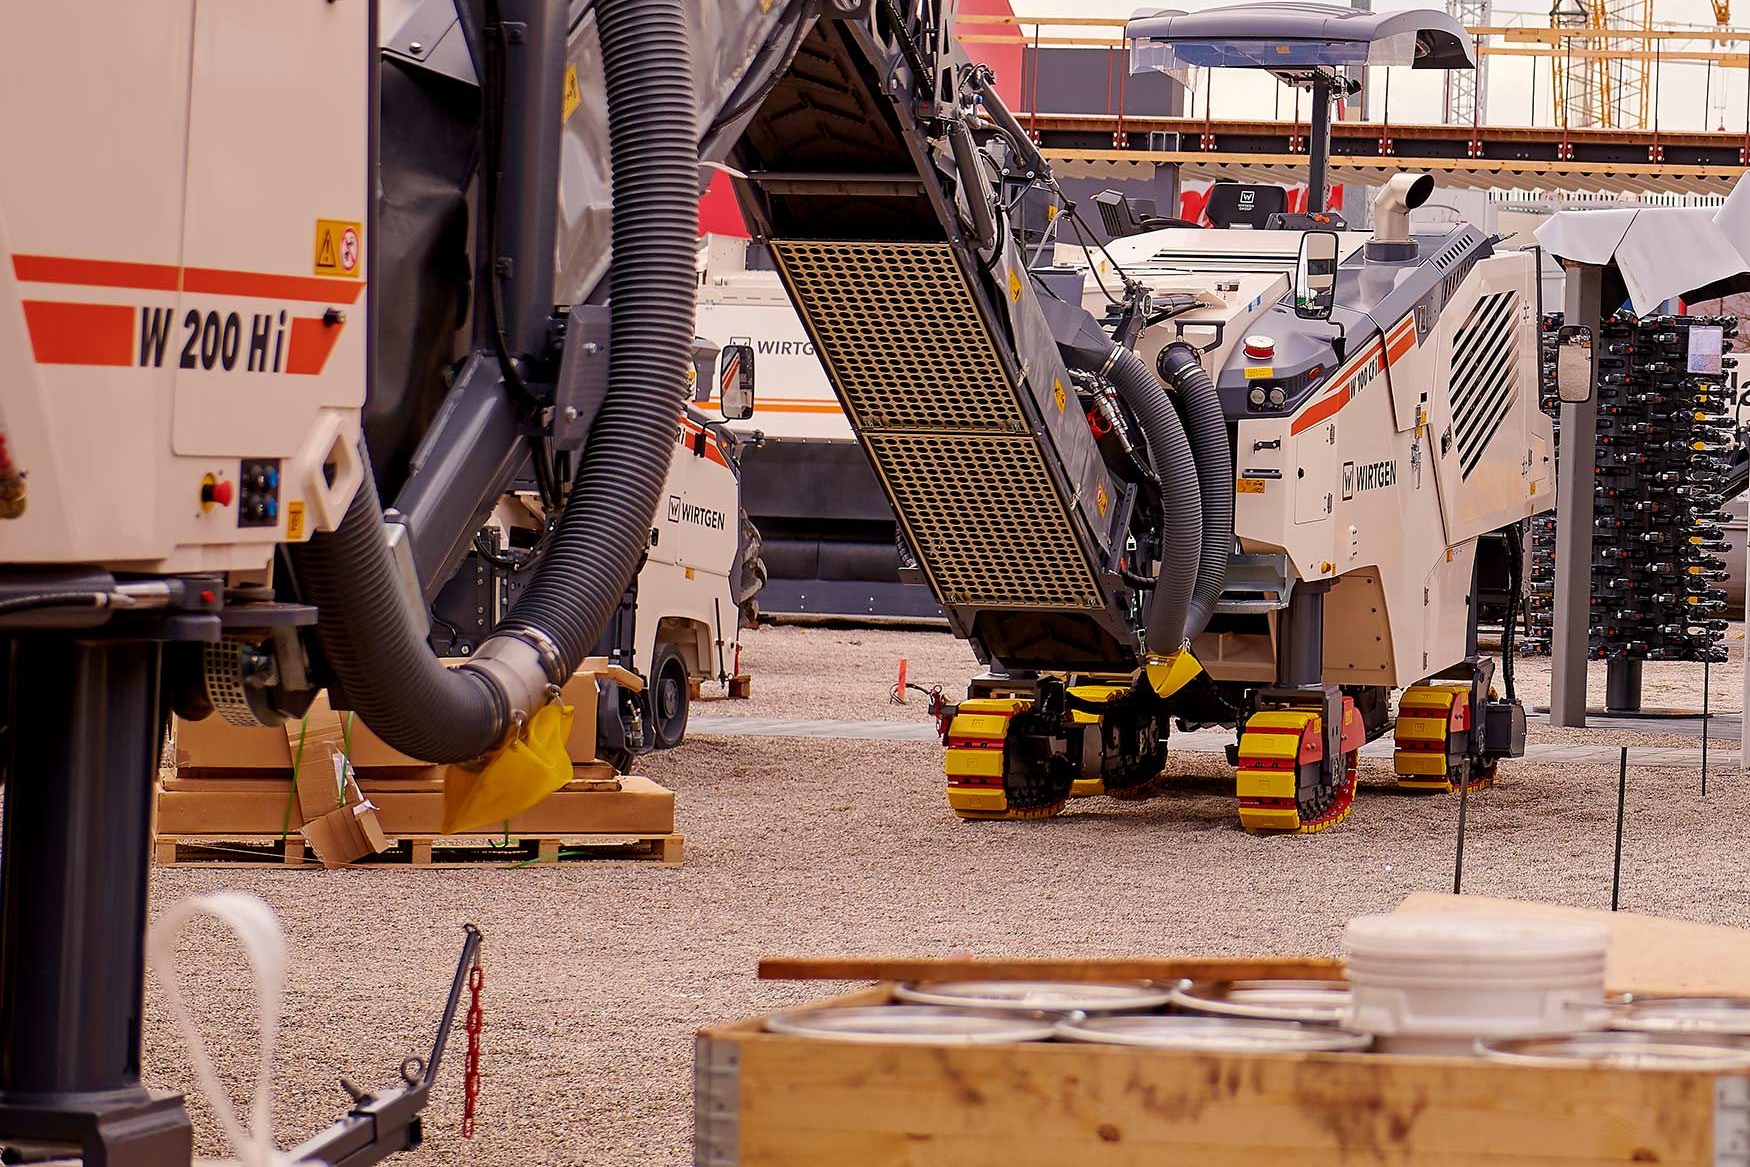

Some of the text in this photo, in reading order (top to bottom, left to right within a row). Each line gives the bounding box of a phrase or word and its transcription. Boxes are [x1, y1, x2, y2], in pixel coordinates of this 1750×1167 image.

[140, 306, 288, 373] W 200 Hi
[1356, 460, 1397, 492] WIRTGEN
[681, 502, 726, 531] WIRTGEN
